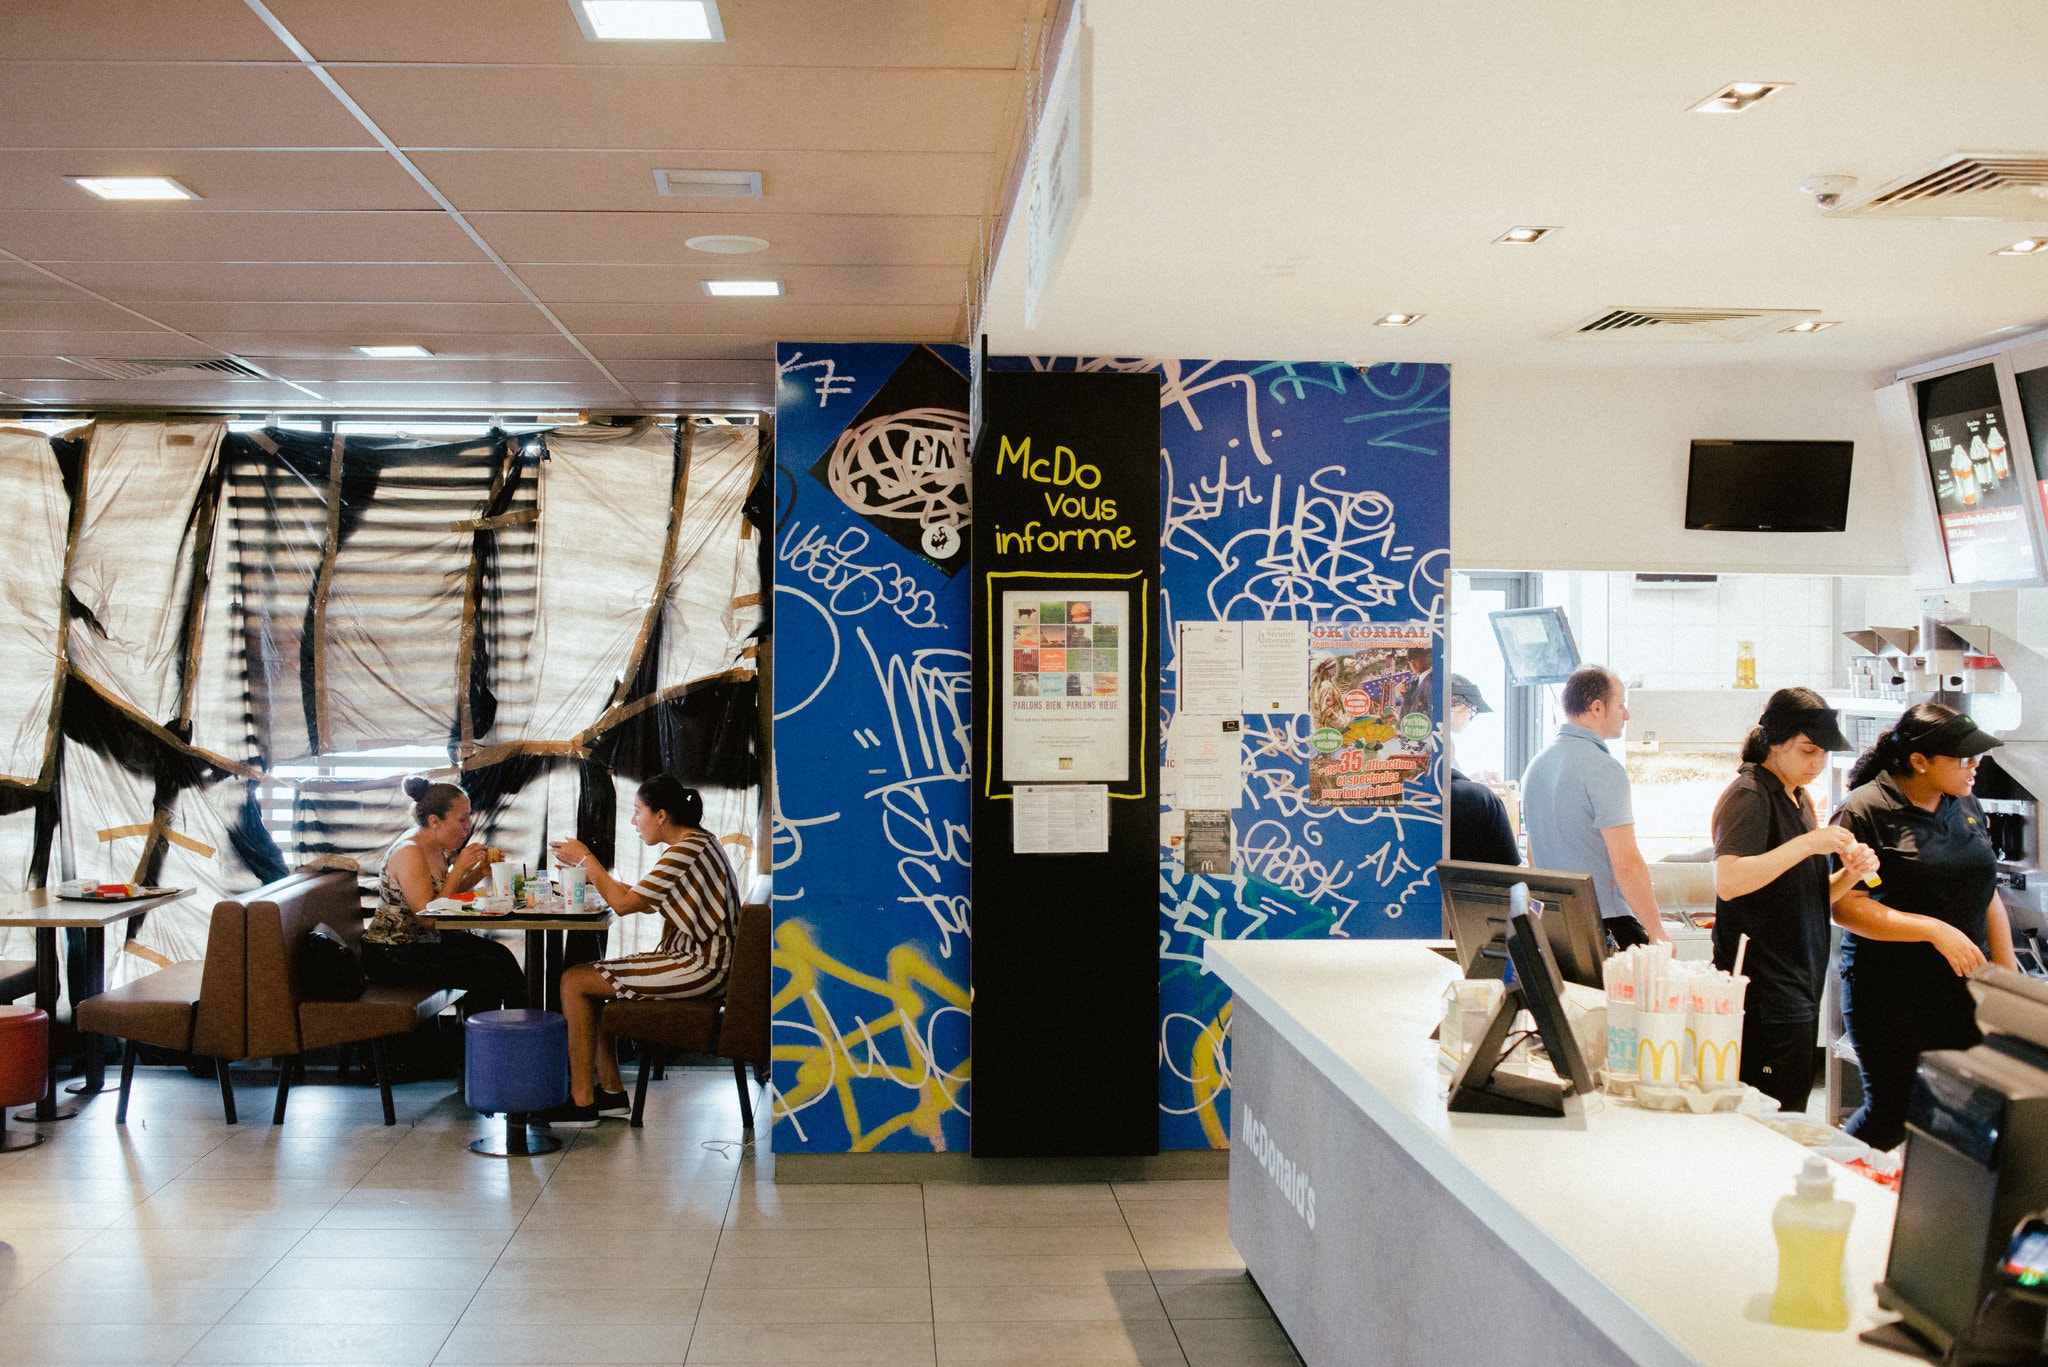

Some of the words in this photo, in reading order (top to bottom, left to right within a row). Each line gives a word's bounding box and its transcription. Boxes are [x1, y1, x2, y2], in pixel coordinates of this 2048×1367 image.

[1929, 436, 1951, 452] PARFAIT
[996, 435, 1102, 490] McDo
[1044, 492, 1118, 522] vous
[994, 520, 1137, 555] informe
[1312, 625, 1343, 639] OK
[1349, 625, 1430, 639] CORRAL
[1013, 700, 1043, 710] PARLONS
[1066, 700, 1096, 710] PARLONS
[1325, 764, 1338, 776] de
[1339, 749, 1364, 773] 35
[1365, 759, 1417, 771] attractions
[1336, 775, 1347, 787] et
[1347, 771, 1400, 786] spectacles
[1322, 789, 1343, 799] pour
[1343, 787, 1365, 799] toute
[1365, 785, 1375, 798] la
[1242, 1103, 1316, 1230] McDonald's
